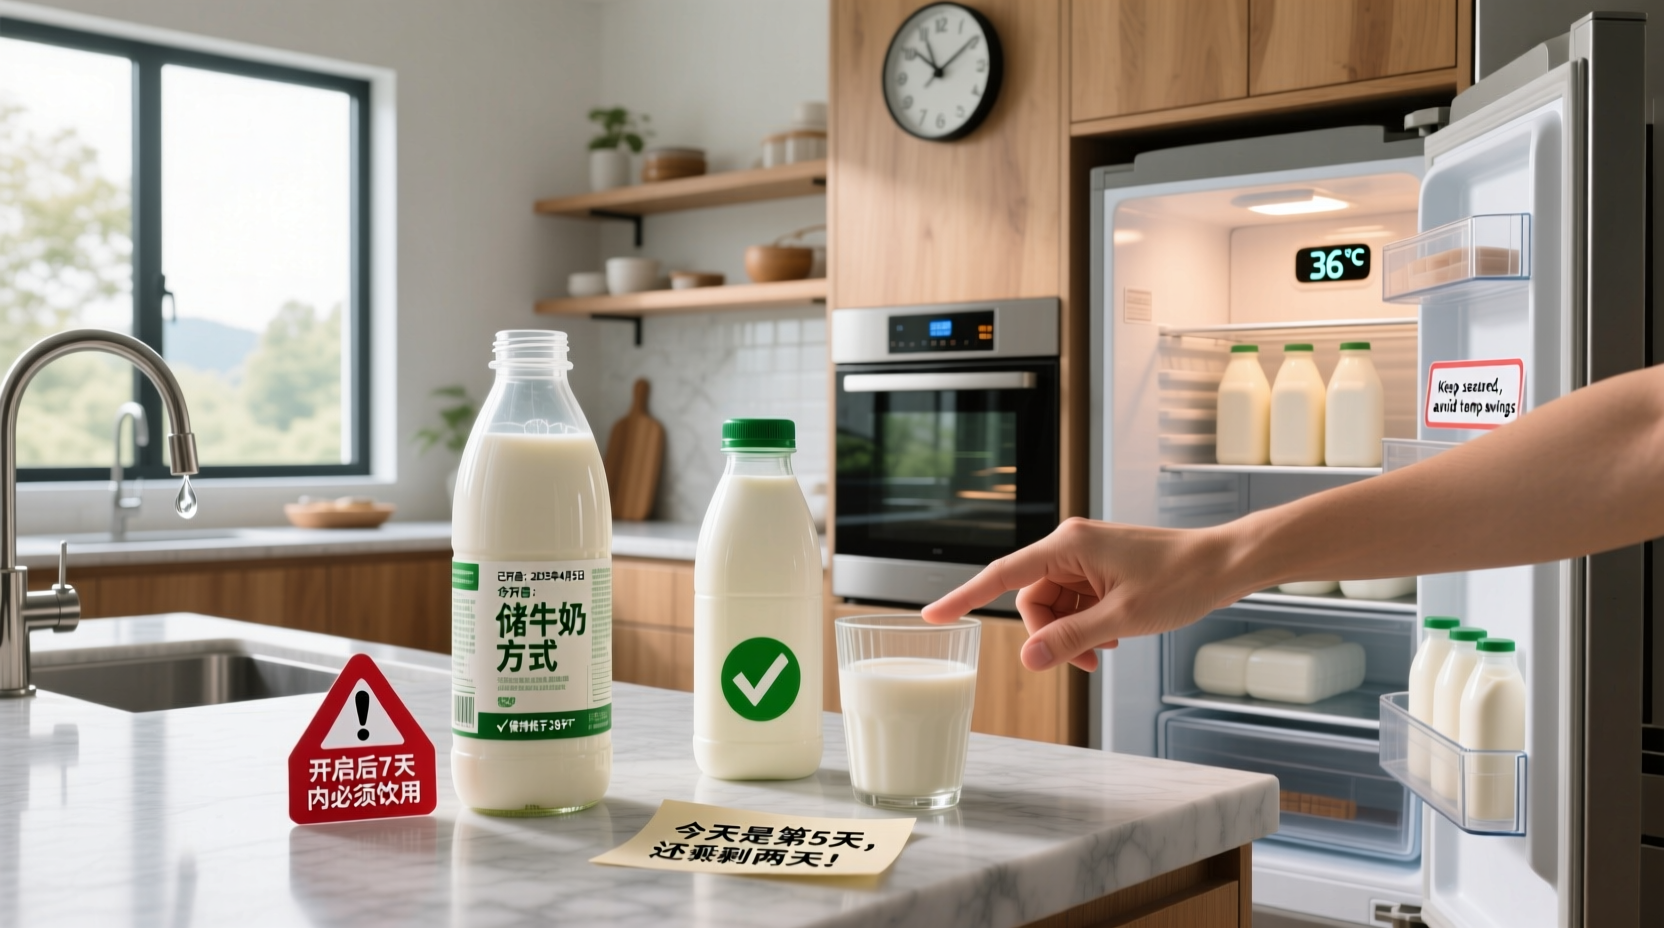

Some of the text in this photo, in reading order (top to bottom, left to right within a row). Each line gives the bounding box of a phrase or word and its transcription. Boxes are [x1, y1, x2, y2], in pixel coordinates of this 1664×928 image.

[935, 17, 949, 34] 12
[935, 112, 946, 130] 6
[495, 601, 587, 639] 储牛奶
[496, 639, 558, 673] 方式
[308, 753, 416, 783] 开启后7天
[307, 780, 421, 812] 内必须饮用
